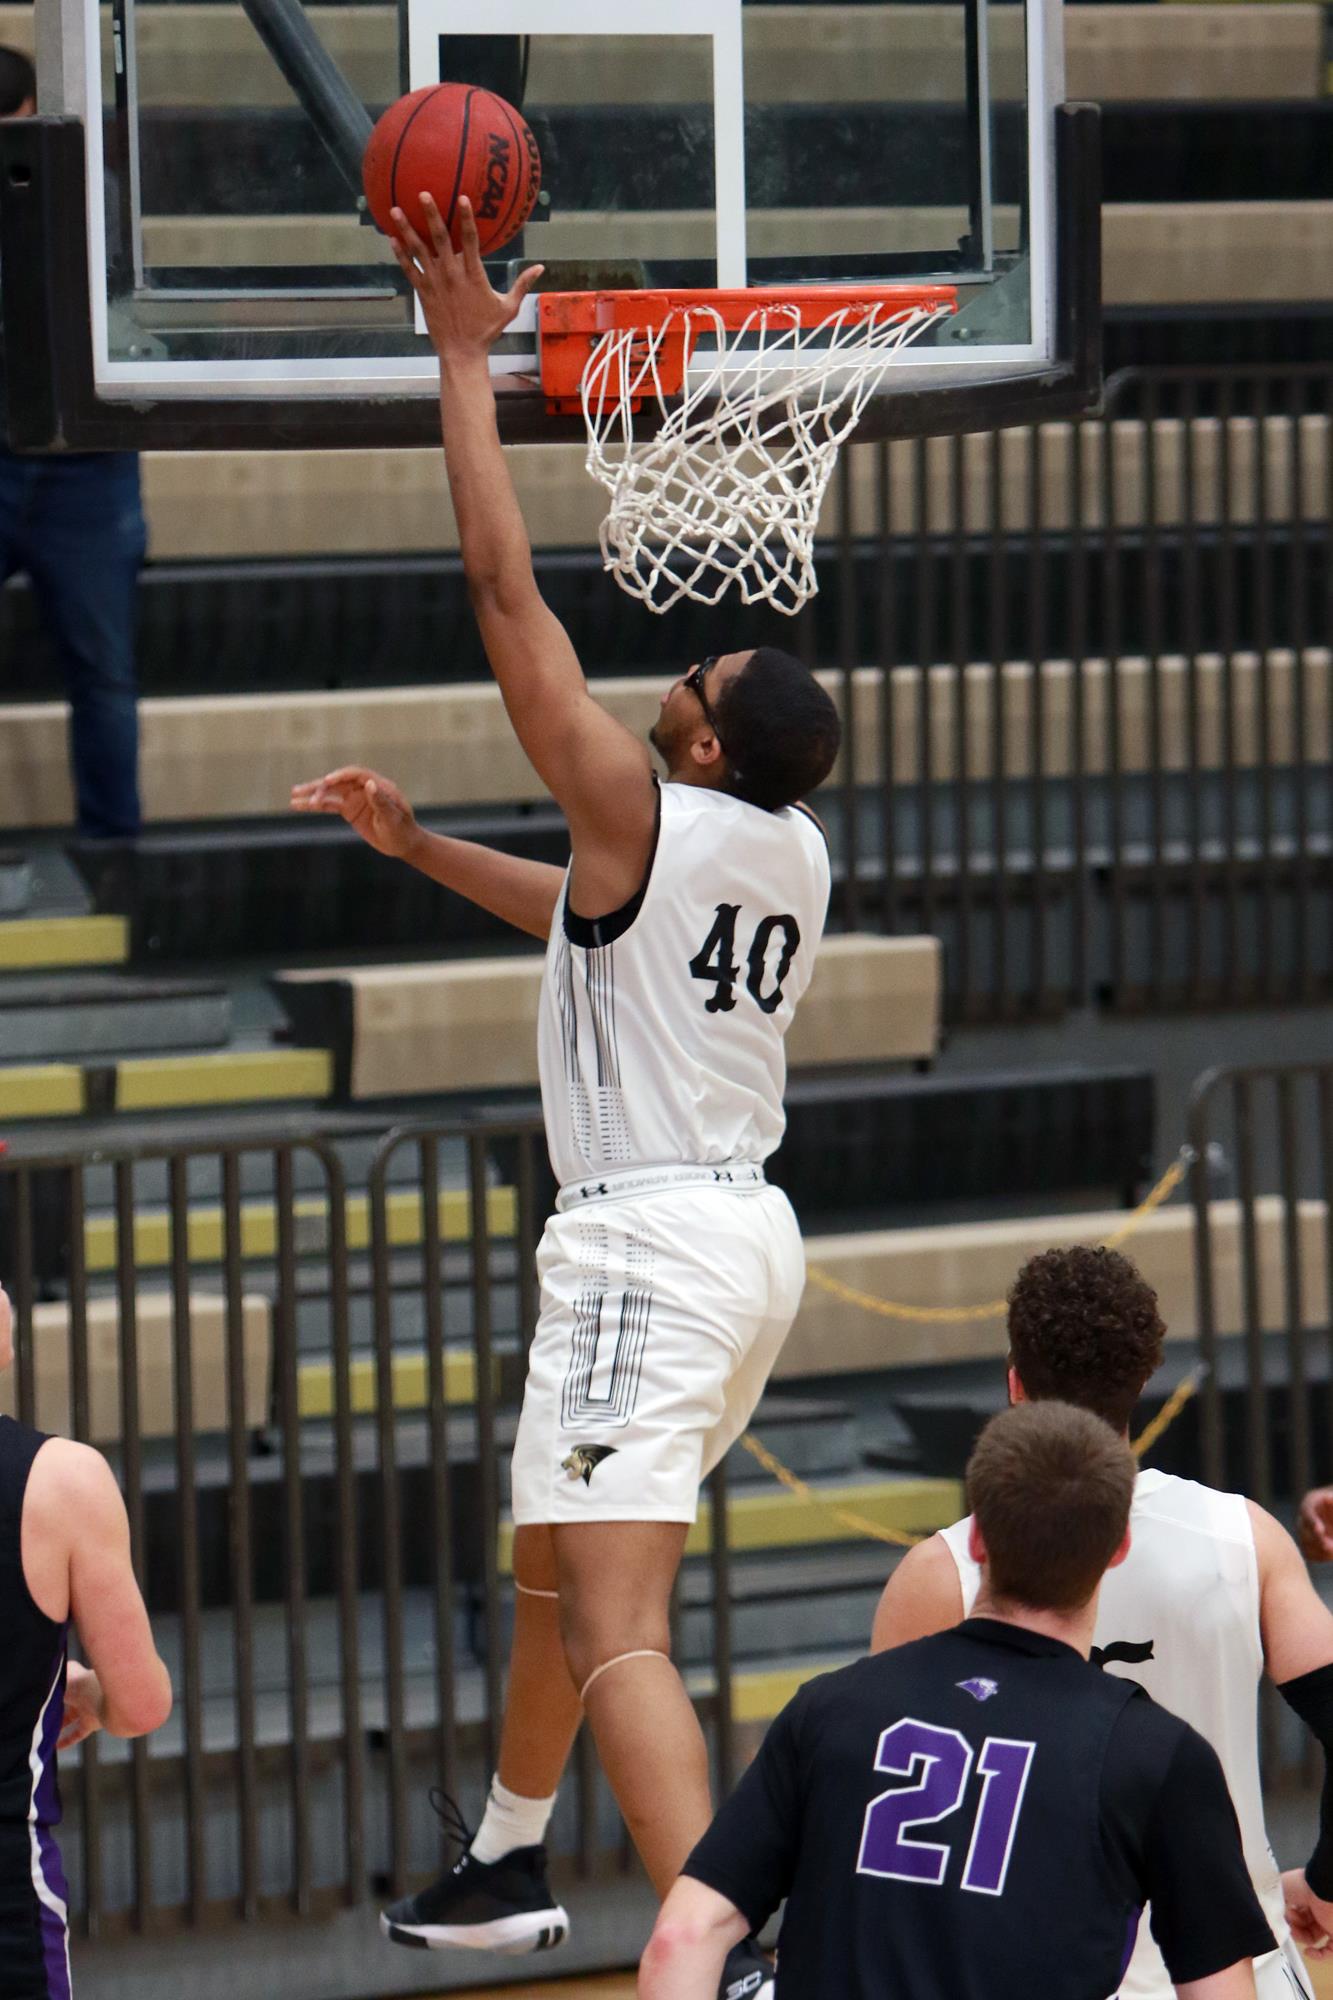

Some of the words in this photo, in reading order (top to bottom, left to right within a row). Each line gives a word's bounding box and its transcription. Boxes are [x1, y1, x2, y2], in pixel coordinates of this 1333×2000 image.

[474, 132, 510, 220] NCAA
[688, 902, 801, 1014] 40
[611, 1174, 669, 1192] ARMOUR
[856, 1716, 1037, 1896] 21
